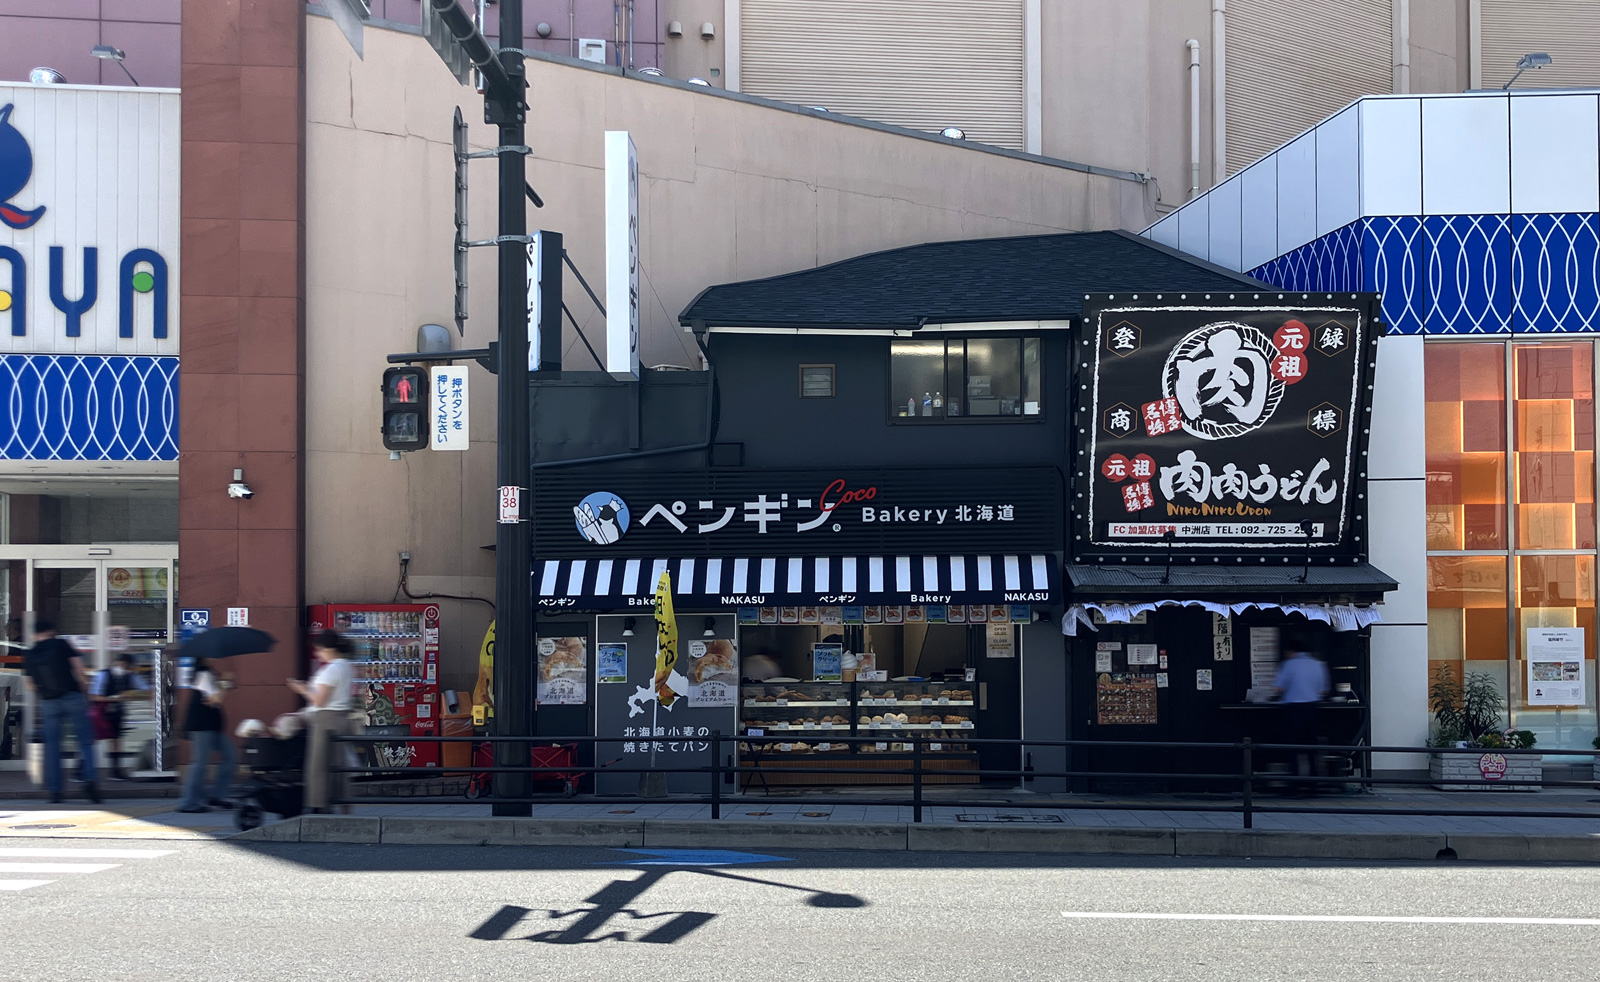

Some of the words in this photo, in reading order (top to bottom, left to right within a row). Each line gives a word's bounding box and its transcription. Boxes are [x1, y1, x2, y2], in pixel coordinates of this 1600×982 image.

[1112, 326, 1137, 351] 登
[1319, 327, 1345, 350] 録
[1276, 328, 1305, 378] 元祖
[1175, 328, 1268, 425] 肉
[437, 374, 448, 444] 押してください
[452, 377, 463, 431] 押ボタンを
[1110, 408, 1131, 430] 商
[1311, 410, 1337, 431] 標
[1106, 459, 1152, 477] 元祖
[1159, 450, 1338, 505] 肉肉うどん
[502, 486, 515, 497] 01
[819, 478, 877, 512] Coco
[502, 497, 517, 508] 38
[638, 493, 836, 534] ペンギン
[862, 506, 948, 525] Bakery
[955, 504, 1016, 522] 北海道
[1113, 525, 1126, 535] FC
[1181, 525, 1211, 536] 中洲店
[538, 597, 577, 607] ペンギン
[628, 597, 657, 607] Bake
[721, 595, 765, 605] NAKASU
[818, 594, 857, 604] ペンギン
[910, 594, 952, 604] Bakery
[1003, 592, 1050, 602] NAKASU
[549, 687, 575, 695] 北海道
[700, 689, 726, 697] 北海道
